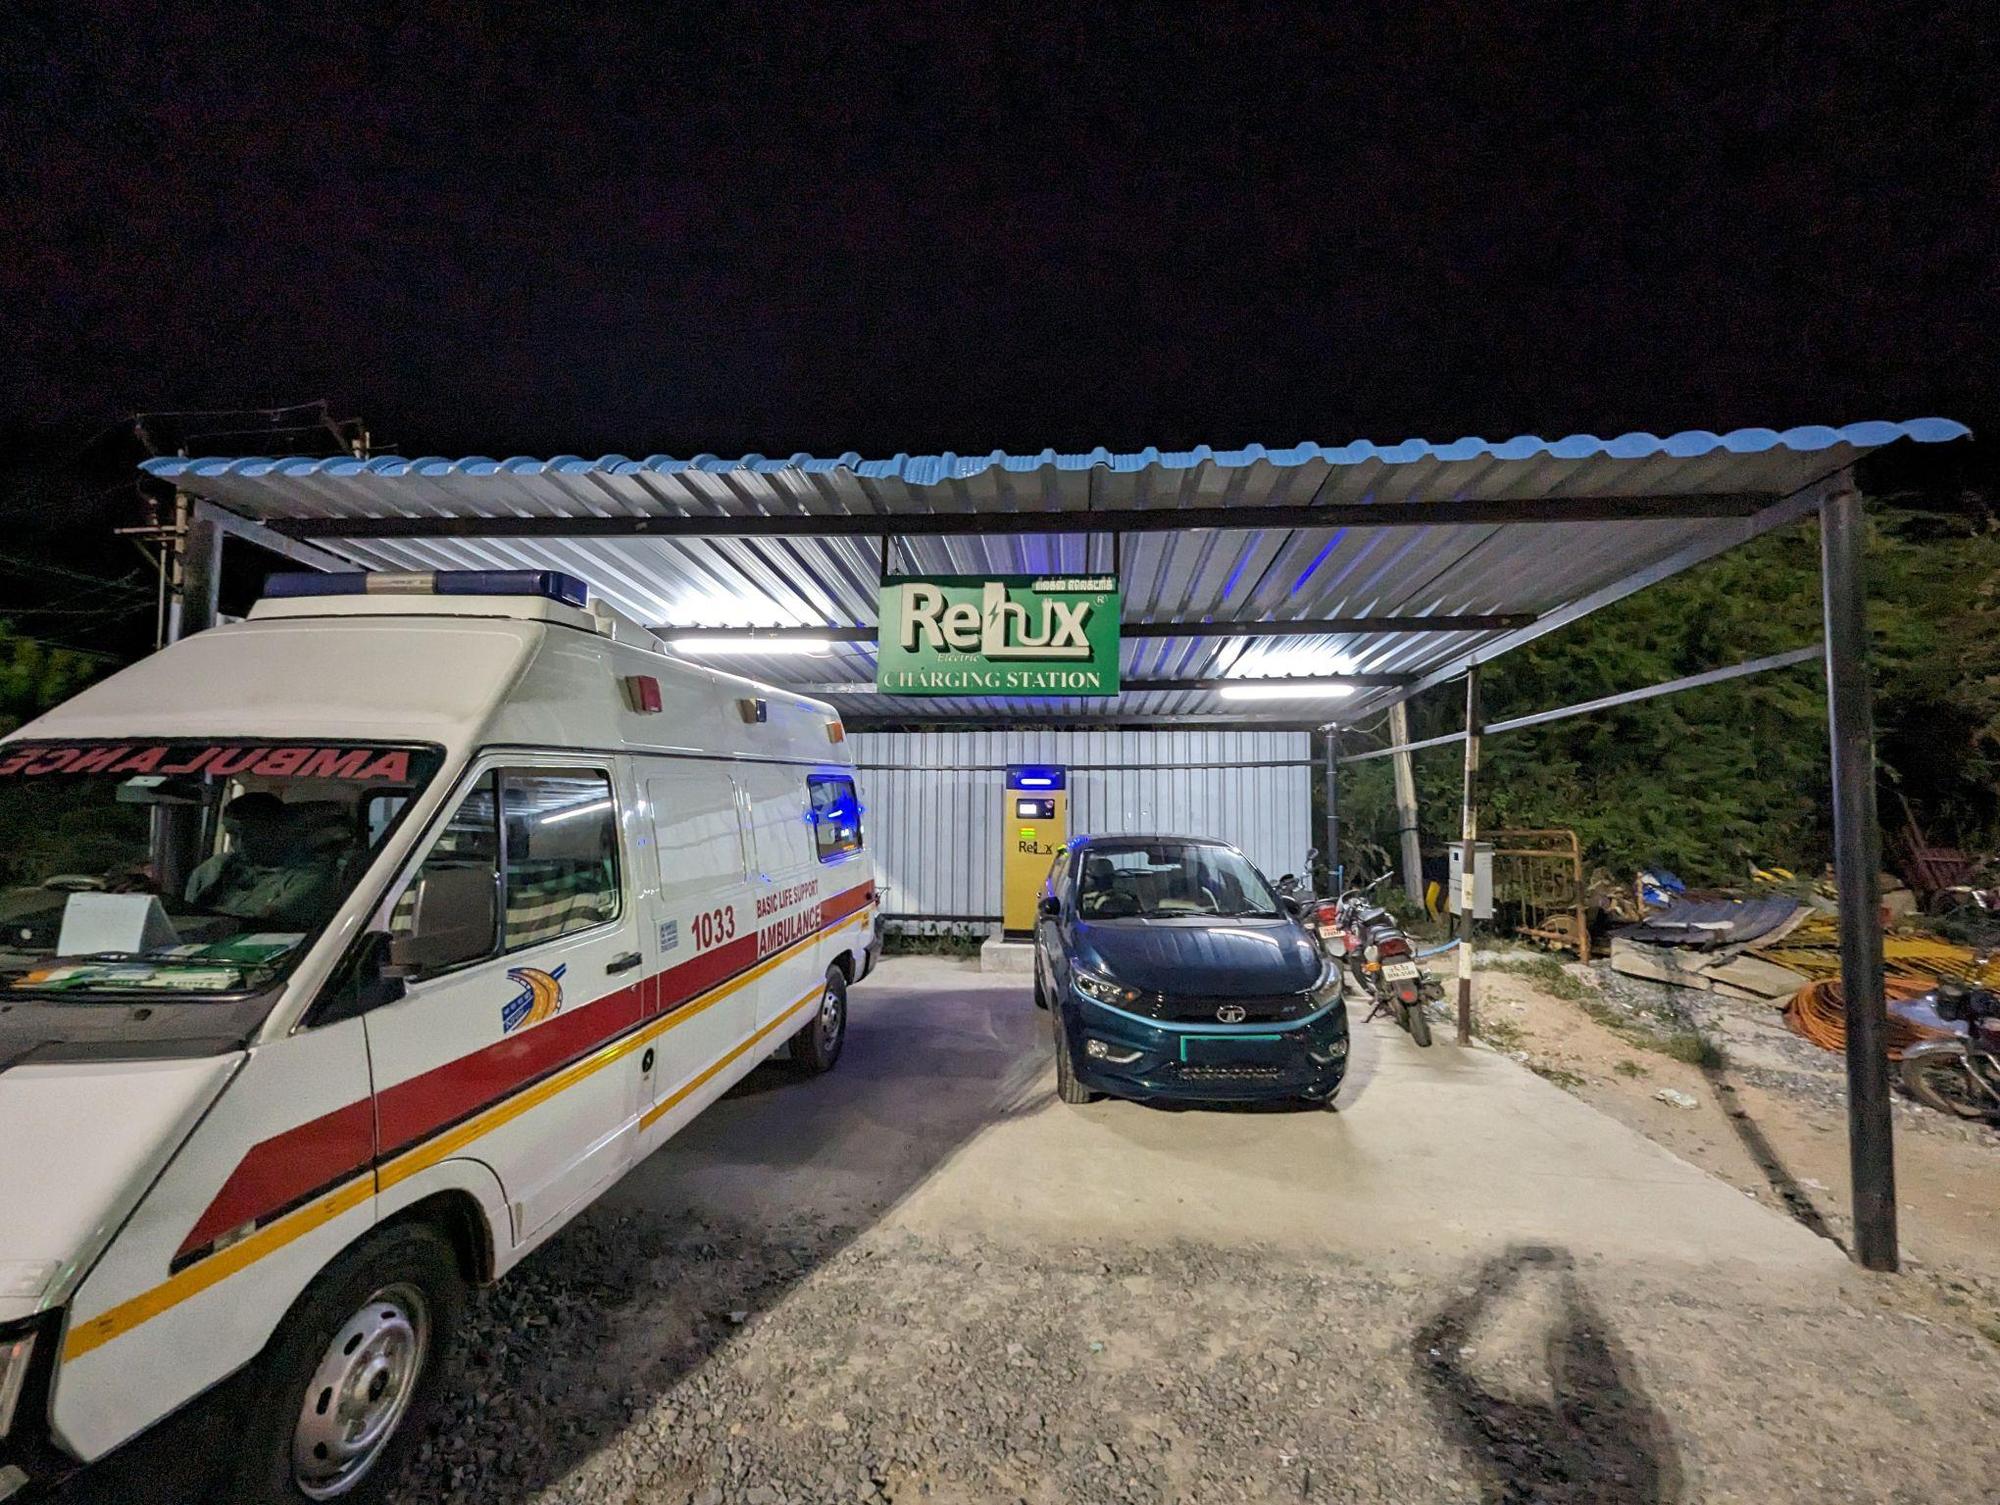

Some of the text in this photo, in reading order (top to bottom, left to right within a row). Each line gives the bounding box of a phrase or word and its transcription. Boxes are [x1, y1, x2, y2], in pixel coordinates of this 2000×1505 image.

[884, 671, 1100, 688] CHARGING STATION
[757, 879, 818, 919] BASIC LIFE SUPPORT
[691, 905, 735, 951] 1033
[759, 903, 820, 957] AMBULANCE
